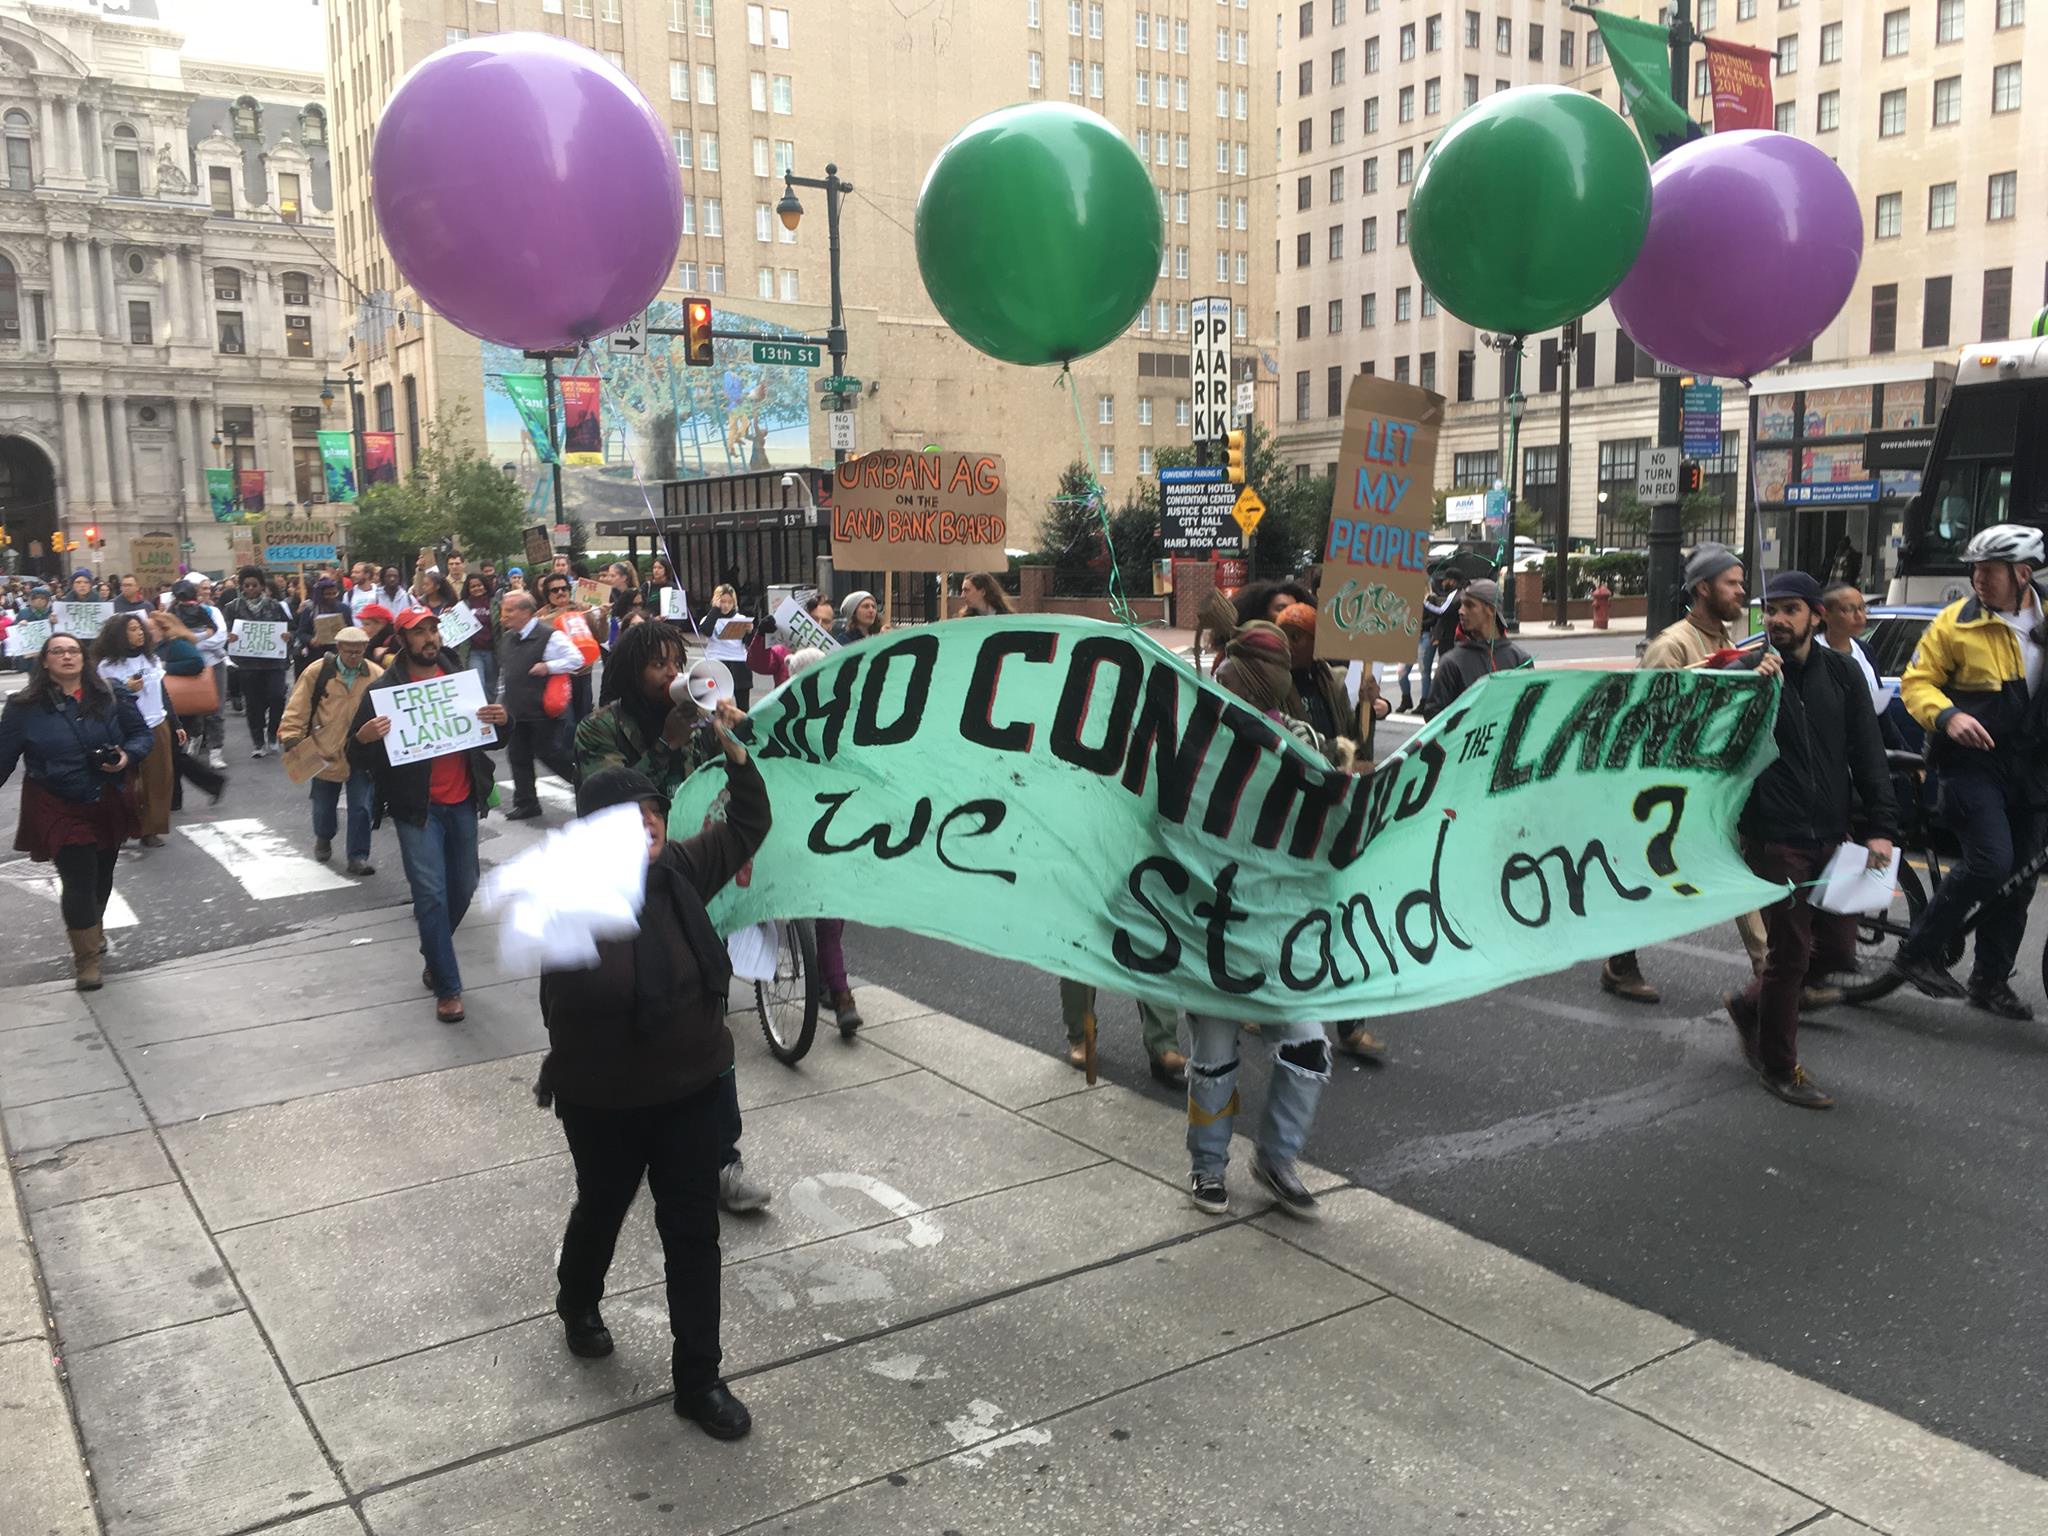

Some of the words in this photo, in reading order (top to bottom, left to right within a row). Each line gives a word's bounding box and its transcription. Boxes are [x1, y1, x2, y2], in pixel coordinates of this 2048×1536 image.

[1713, 64, 1766, 89] DECEMBER
[1716, 79, 1743, 96] 2018
[616, 323, 641, 334] AY
[760, 347, 792, 361] 13th
[798, 349, 814, 362] St
[1194, 319, 1206, 436] PARK
[1213, 319, 1227, 436] PARK
[835, 415, 848, 423] NO
[1363, 417, 1416, 467] LET
[1651, 453, 1666, 465] NO
[838, 453, 941, 491] URBAN
[948, 455, 1000, 496] AG
[1645, 468, 1672, 480] TURN
[1166, 485, 1205, 494] MARRIOT
[1207, 483, 1235, 493] HOTEL
[1354, 467, 1410, 515] MY
[1640, 485, 1653, 495] ON
[1656, 483, 1676, 494] RED
[895, 494, 913, 506] ON
[917, 495, 939, 508] THE
[1166, 495, 1208, 505] CONVENTION
[1210, 494, 1236, 504] CENTER
[1456, 499, 1474, 508] ABM
[1166, 506, 1200, 516] JUSTICE
[264, 521, 331, 533] GROWING
[833, 505, 885, 543] LAND
[887, 509, 938, 543] BANK
[939, 510, 1006, 544] BOARD
[1179, 517, 1198, 527] CITY
[1201, 516, 1223, 526] HALL
[266, 530, 335, 544] COMMUNITY
[1185, 527, 1217, 537] MACY'S
[1164, 539, 1188, 548] HARD
[1190, 538, 1214, 547] ROCK
[1216, 537, 1239, 546] CAFE
[1325, 517, 1429, 573] PEOPLE
[65, 604, 101, 613] FREE
[71, 613, 97, 622] THE
[242, 622, 276, 633] FREE
[789, 610, 834, 655] FREE
[245, 631, 272, 640] THE
[239, 640, 276, 651] LAND
[392, 679, 459, 709] FREE
[402, 699, 458, 726] THE
[400, 716, 472, 748] LAND
[1457, 721, 1498, 763] THE
[1488, 672, 1776, 797] LAND
[807, 786, 1016, 884] we
